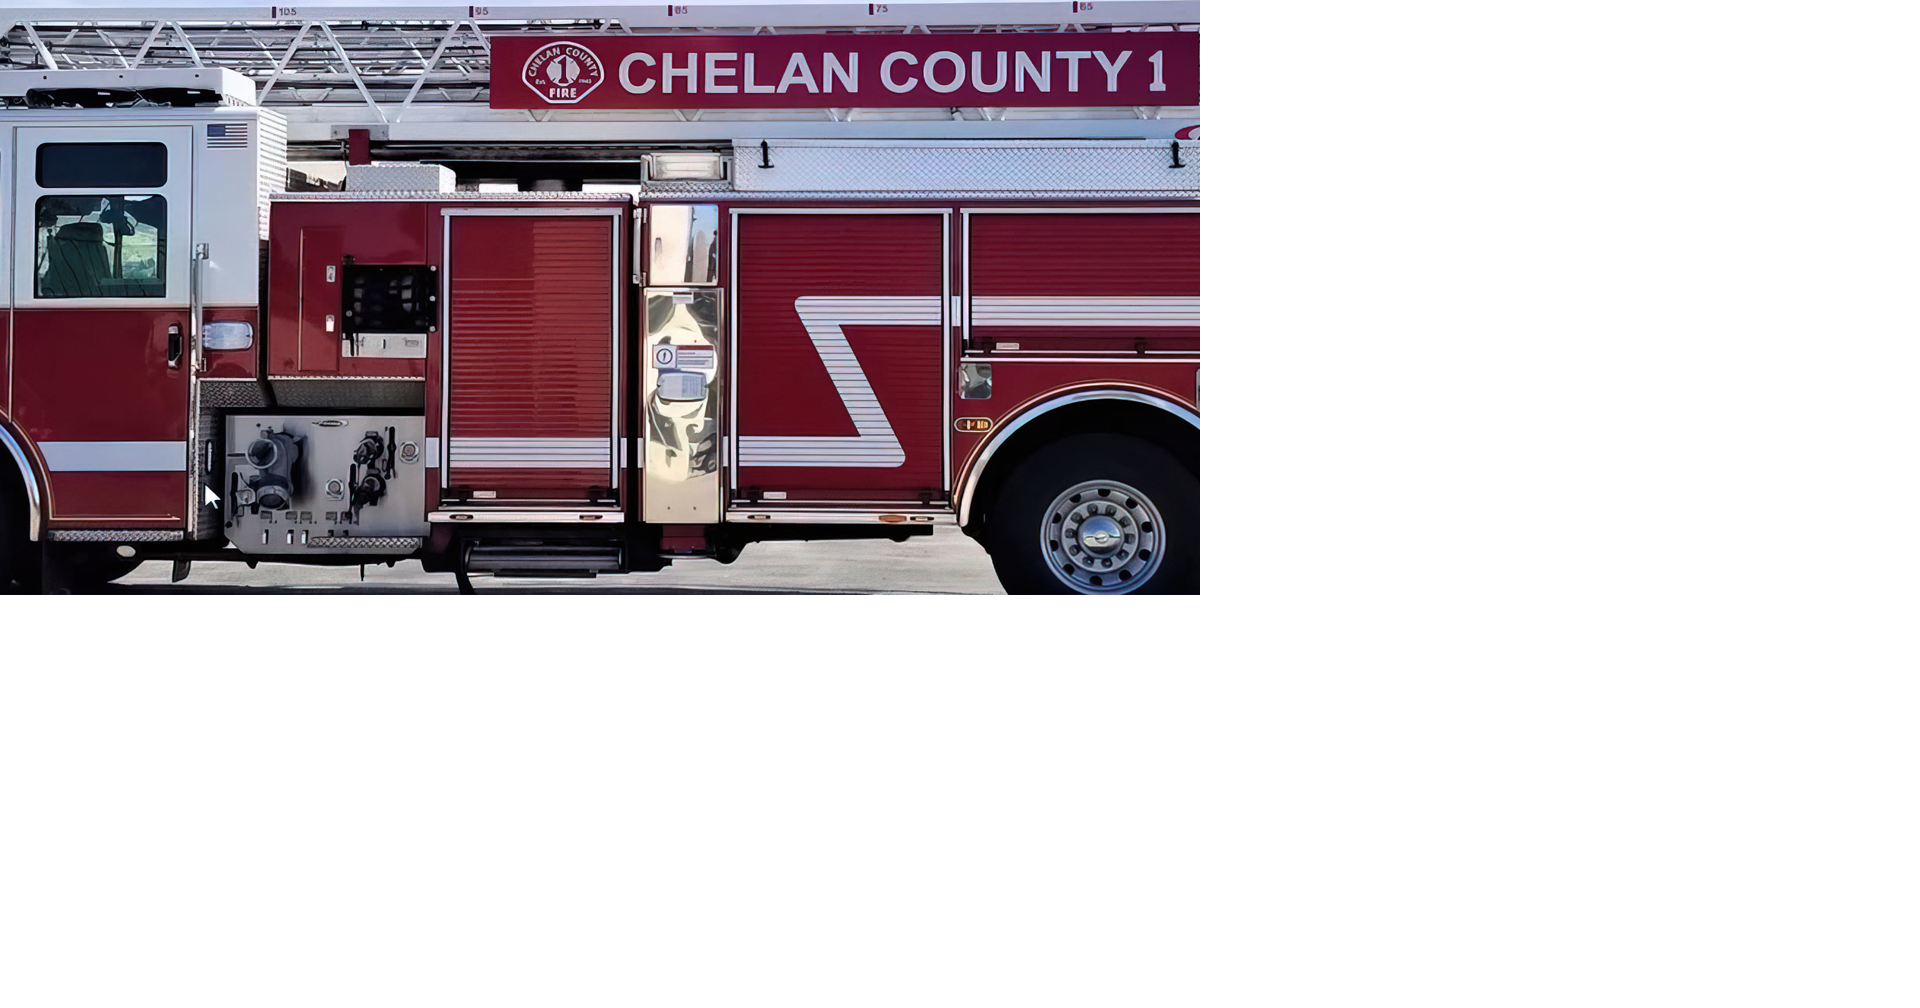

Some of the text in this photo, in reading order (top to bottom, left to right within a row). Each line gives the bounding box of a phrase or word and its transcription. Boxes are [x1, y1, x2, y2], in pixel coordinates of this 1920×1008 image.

[528, 47, 598, 77] CHELAN COUNTY
[557, 56, 569, 83] 1
[619, 50, 1167, 94] CHELAN COUNTY 1
[549, 87, 577, 98] FIRE
